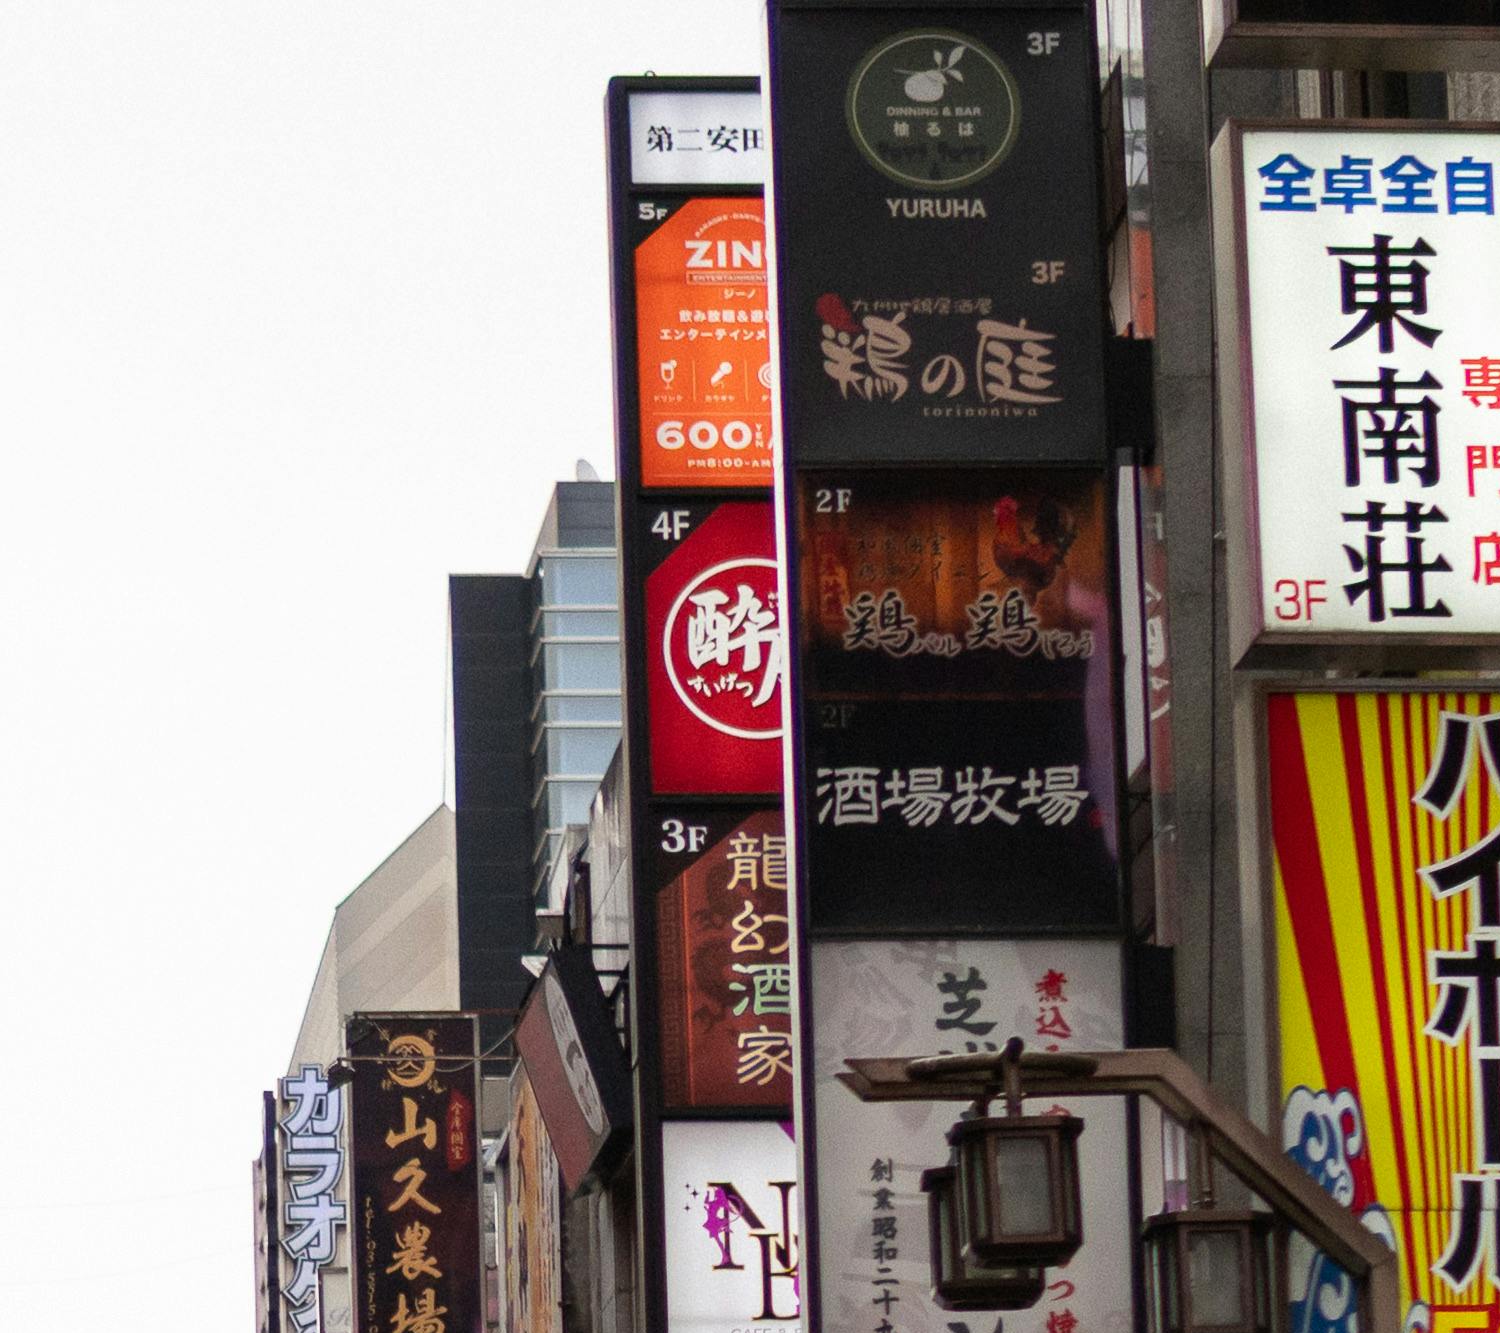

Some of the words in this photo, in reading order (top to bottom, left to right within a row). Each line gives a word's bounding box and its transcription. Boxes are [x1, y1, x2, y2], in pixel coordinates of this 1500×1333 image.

[1027, 32, 1061, 55] 3F
[955, 107, 982, 117] BAR
[639, 203, 668, 221] 5F
[886, 198, 987, 219] YURUHA
[1031, 261, 1065, 285] 3F
[723, 289, 757, 299] ジーノ
[821, 311, 1064, 403] 鶏の庭
[923, 406, 1038, 417] torinoniwa
[656, 421, 753, 450] 600
[1325, 234, 1453, 622] 東南荘
[815, 488, 852, 513] 2F
[651, 511, 691, 540] 4F
[1275, 580, 1327, 621] 3F
[816, 765, 1088, 827] 酒場牧場
[662, 819, 708, 854] 3F
